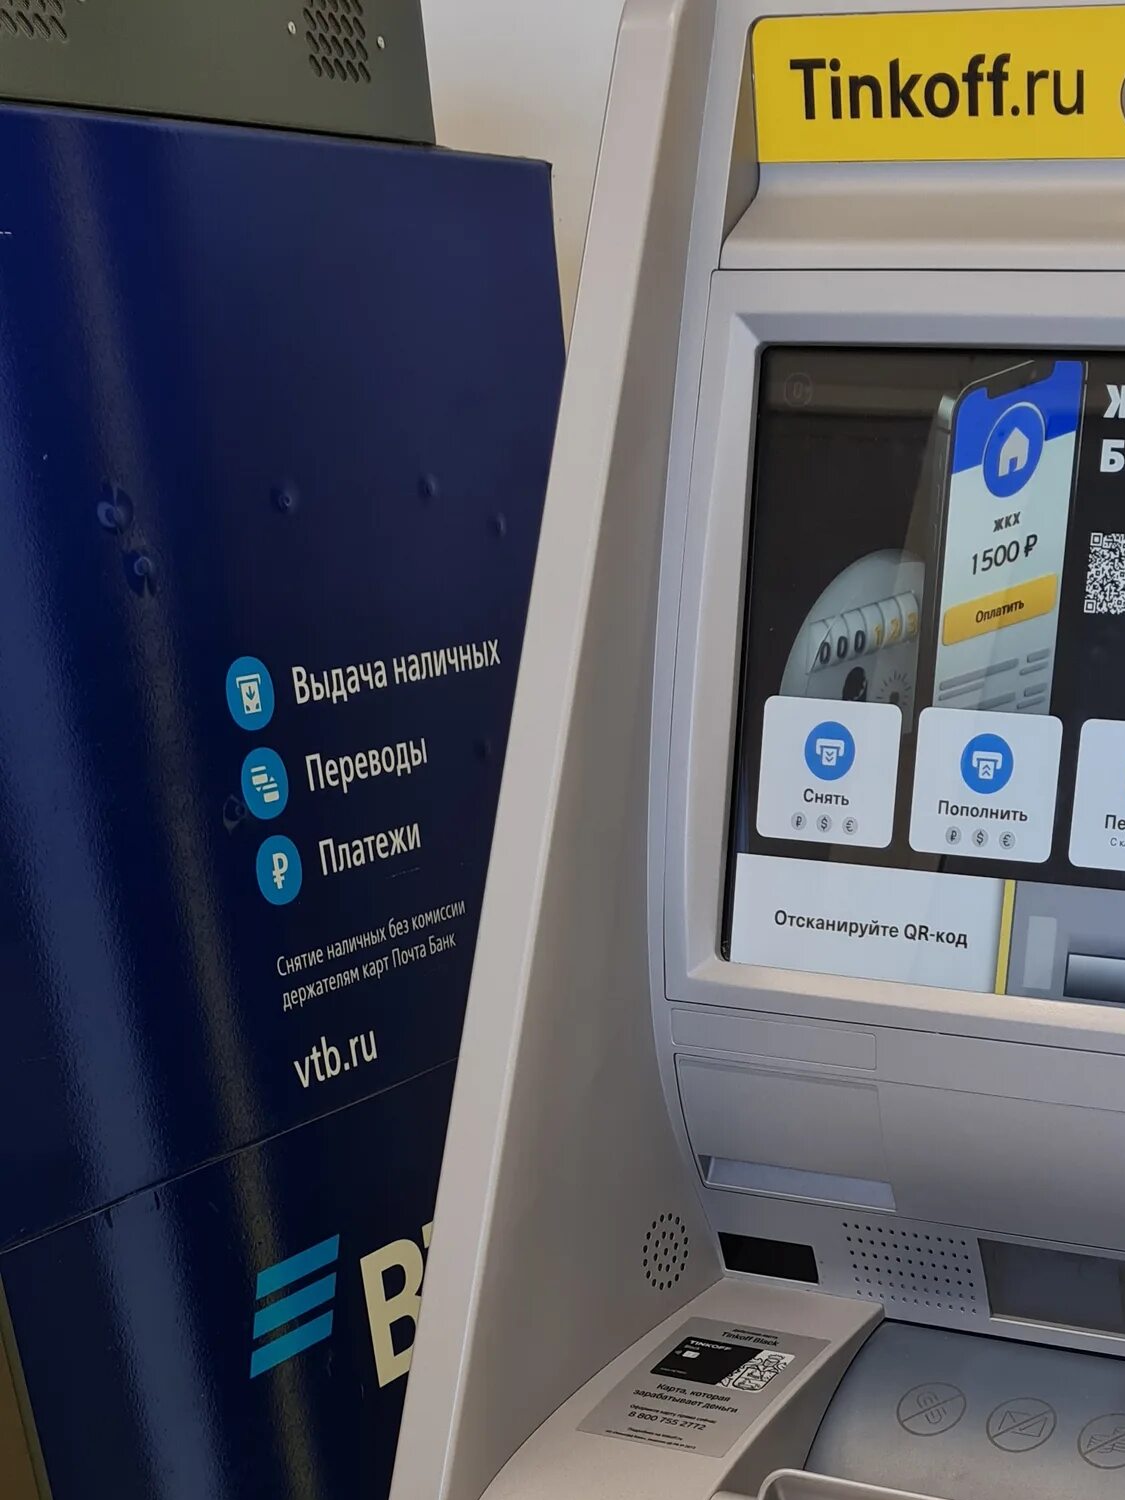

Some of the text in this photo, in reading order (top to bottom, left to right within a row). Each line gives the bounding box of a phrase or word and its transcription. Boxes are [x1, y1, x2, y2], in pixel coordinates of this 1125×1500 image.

[790, 53, 1086, 121] Tinkoff.ru
[993, 512, 1021, 533] ЖКХ
[971, 540, 1020, 575] 1500
[975, 598, 1025, 624] Оплатить
[291, 639, 501, 704] Выдача наличных
[305, 738, 428, 794] Переводы
[803, 788, 850, 807] Снять
[937, 800, 1029, 823] Пополнить
[318, 823, 422, 876] Платежи
[276, 900, 466, 976] Снятие наличных без комиссии
[774, 909, 969, 949] Отсканируйте QR-код
[282, 932, 456, 1012] держателям карт Почта Банк
[293, 1030, 378, 1089] vtb.ru
[690, 1339, 732, 1351] TINKOFF
[632, 1388, 738, 1414] зарабатывает деньги
[656, 1383, 731, 1402] Карта, которая
[637, 1412, 659, 1422] 800
[659, 1416, 679, 1426] 755
[679, 1419, 707, 1431] 2772
